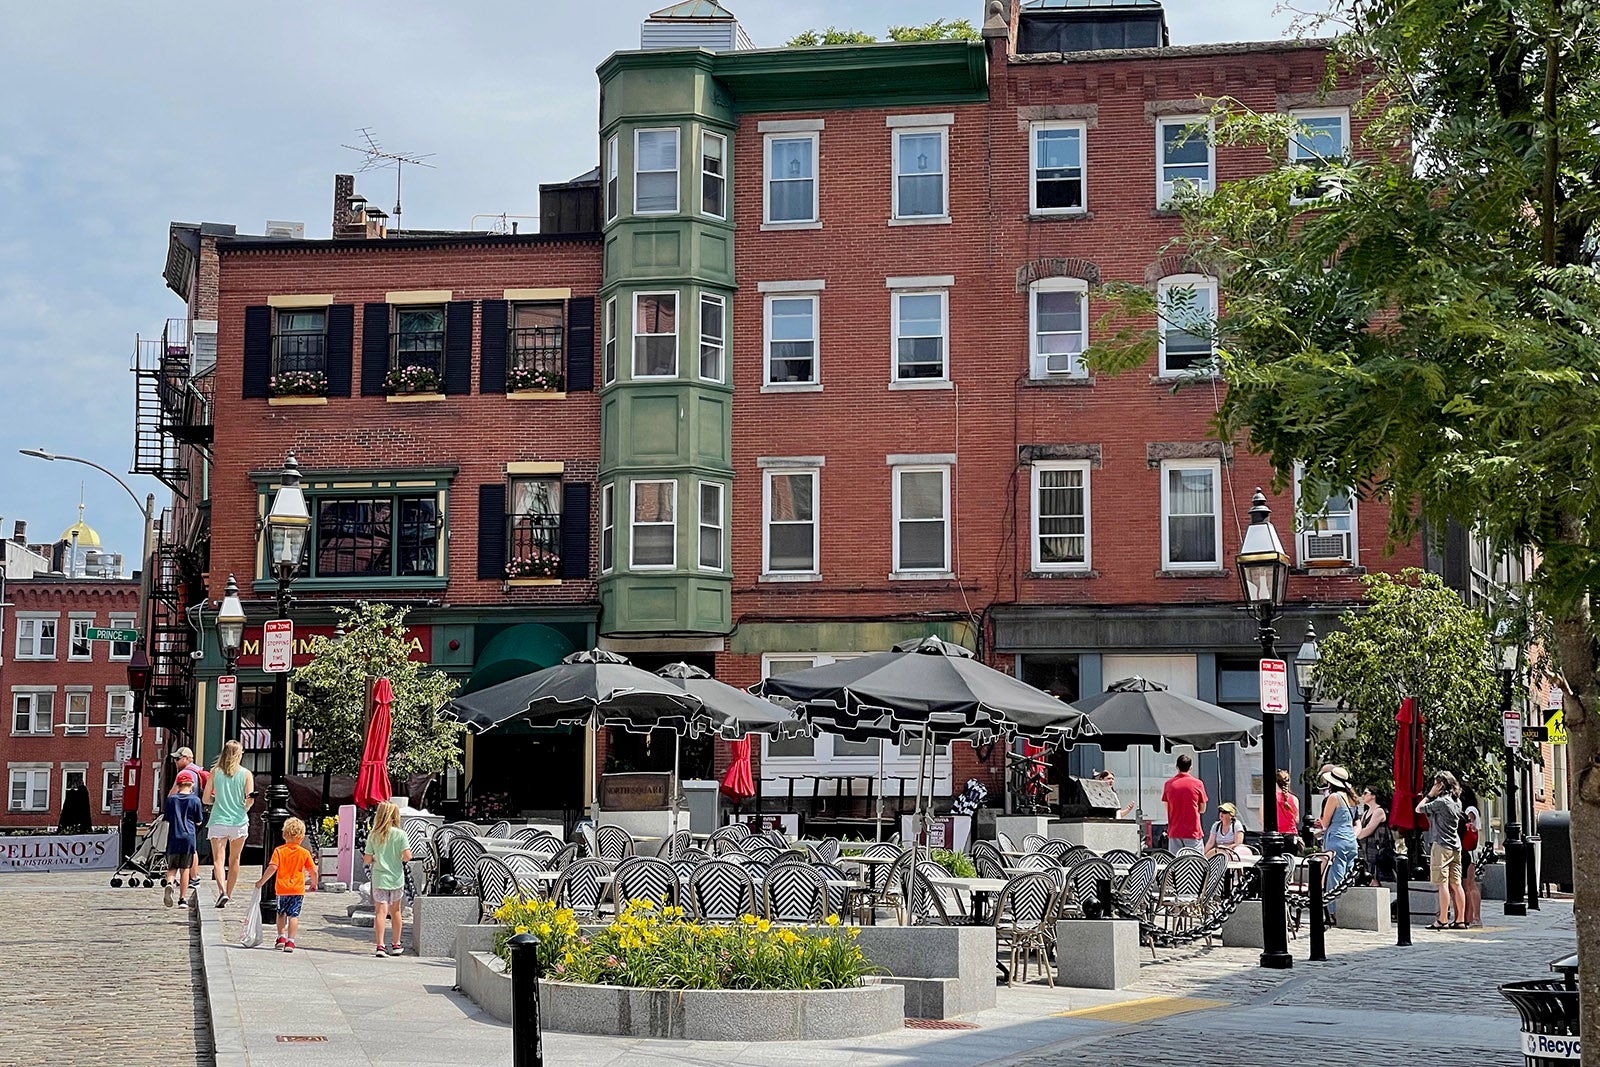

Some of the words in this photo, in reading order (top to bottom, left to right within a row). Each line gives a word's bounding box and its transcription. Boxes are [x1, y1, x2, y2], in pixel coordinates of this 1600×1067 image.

[96, 630, 123, 640] PRINCE
[606, 786, 630, 795] NORTH
[630, 785, 664, 795] SQUARE
[1538, 1035, 1581, 1058] Recyc
